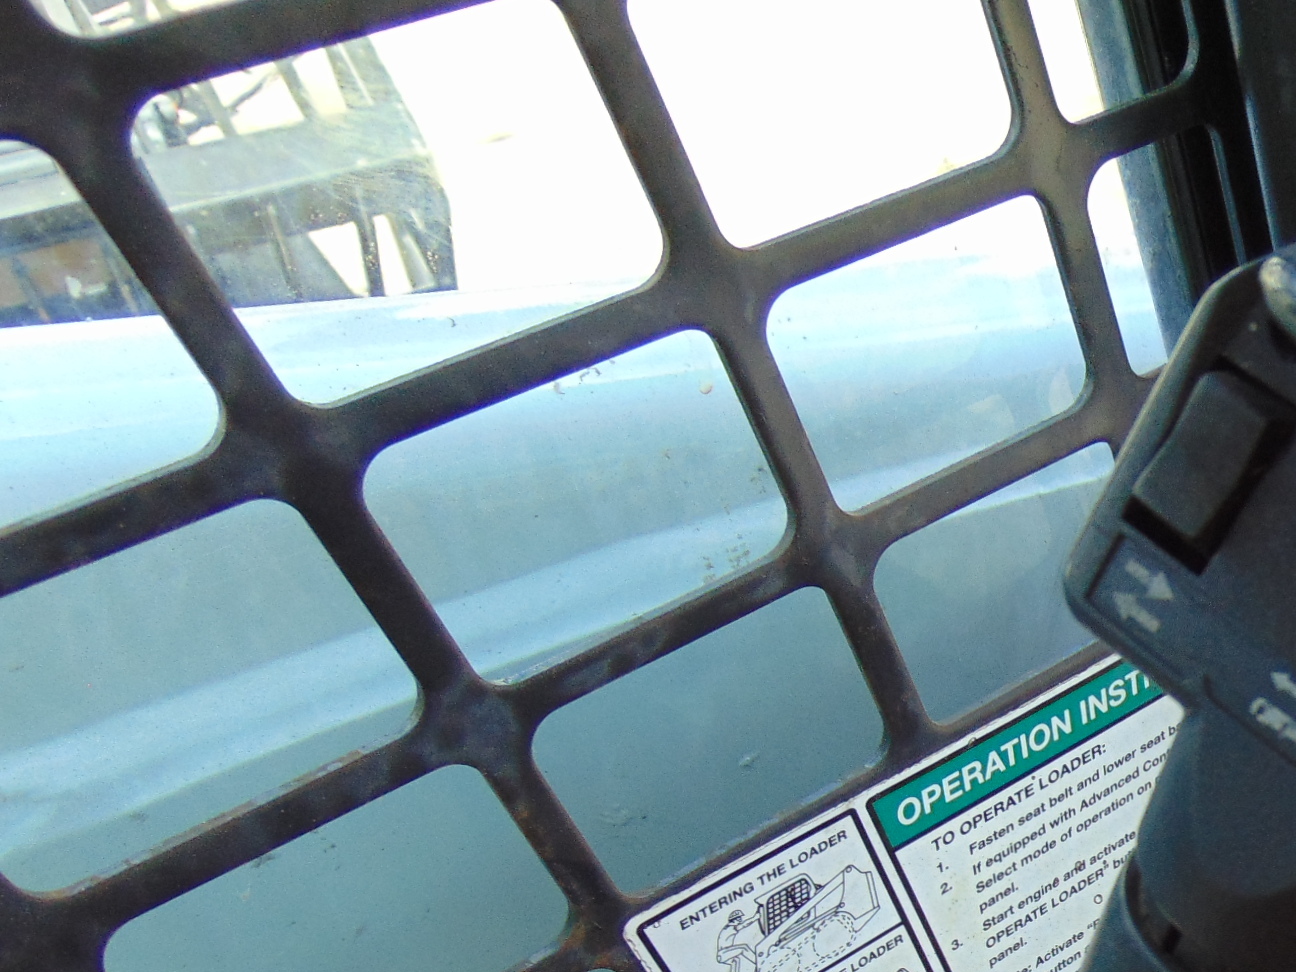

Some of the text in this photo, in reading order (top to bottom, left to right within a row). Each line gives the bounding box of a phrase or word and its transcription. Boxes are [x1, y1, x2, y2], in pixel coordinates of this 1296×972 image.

[897, 708, 1073, 826] OPERATION
[931, 743, 1107, 852] TO OPERATE LOADER:
[937, 862, 949, 873] 1.
[969, 823, 1014, 855] Fasten
[1018, 803, 1046, 826] seat
[1049, 787, 1074, 808] belt
[1077, 769, 1100, 791] and
[1103, 749, 1137, 775] lower
[1140, 731, 1165, 753] seat
[679, 830, 848, 931] ENTERING THE LOADER
[940, 882, 953, 895] 2.
[972, 863, 982, 875] If
[986, 826, 1046, 868] equipped
[1049, 808, 1076, 829] with
[1079, 766, 1140, 811] Advanced
[976, 781, 1152, 893] Select mode of operation on
[951, 831, 1137, 951] 3. Start engine and activate
[979, 882, 1019, 914] panel.
[985, 904, 1049, 949] OPERATE
[850, 934, 904, 972] LOADER
[988, 937, 1027, 968] panel.
[1036, 931, 1085, 968] Activate
